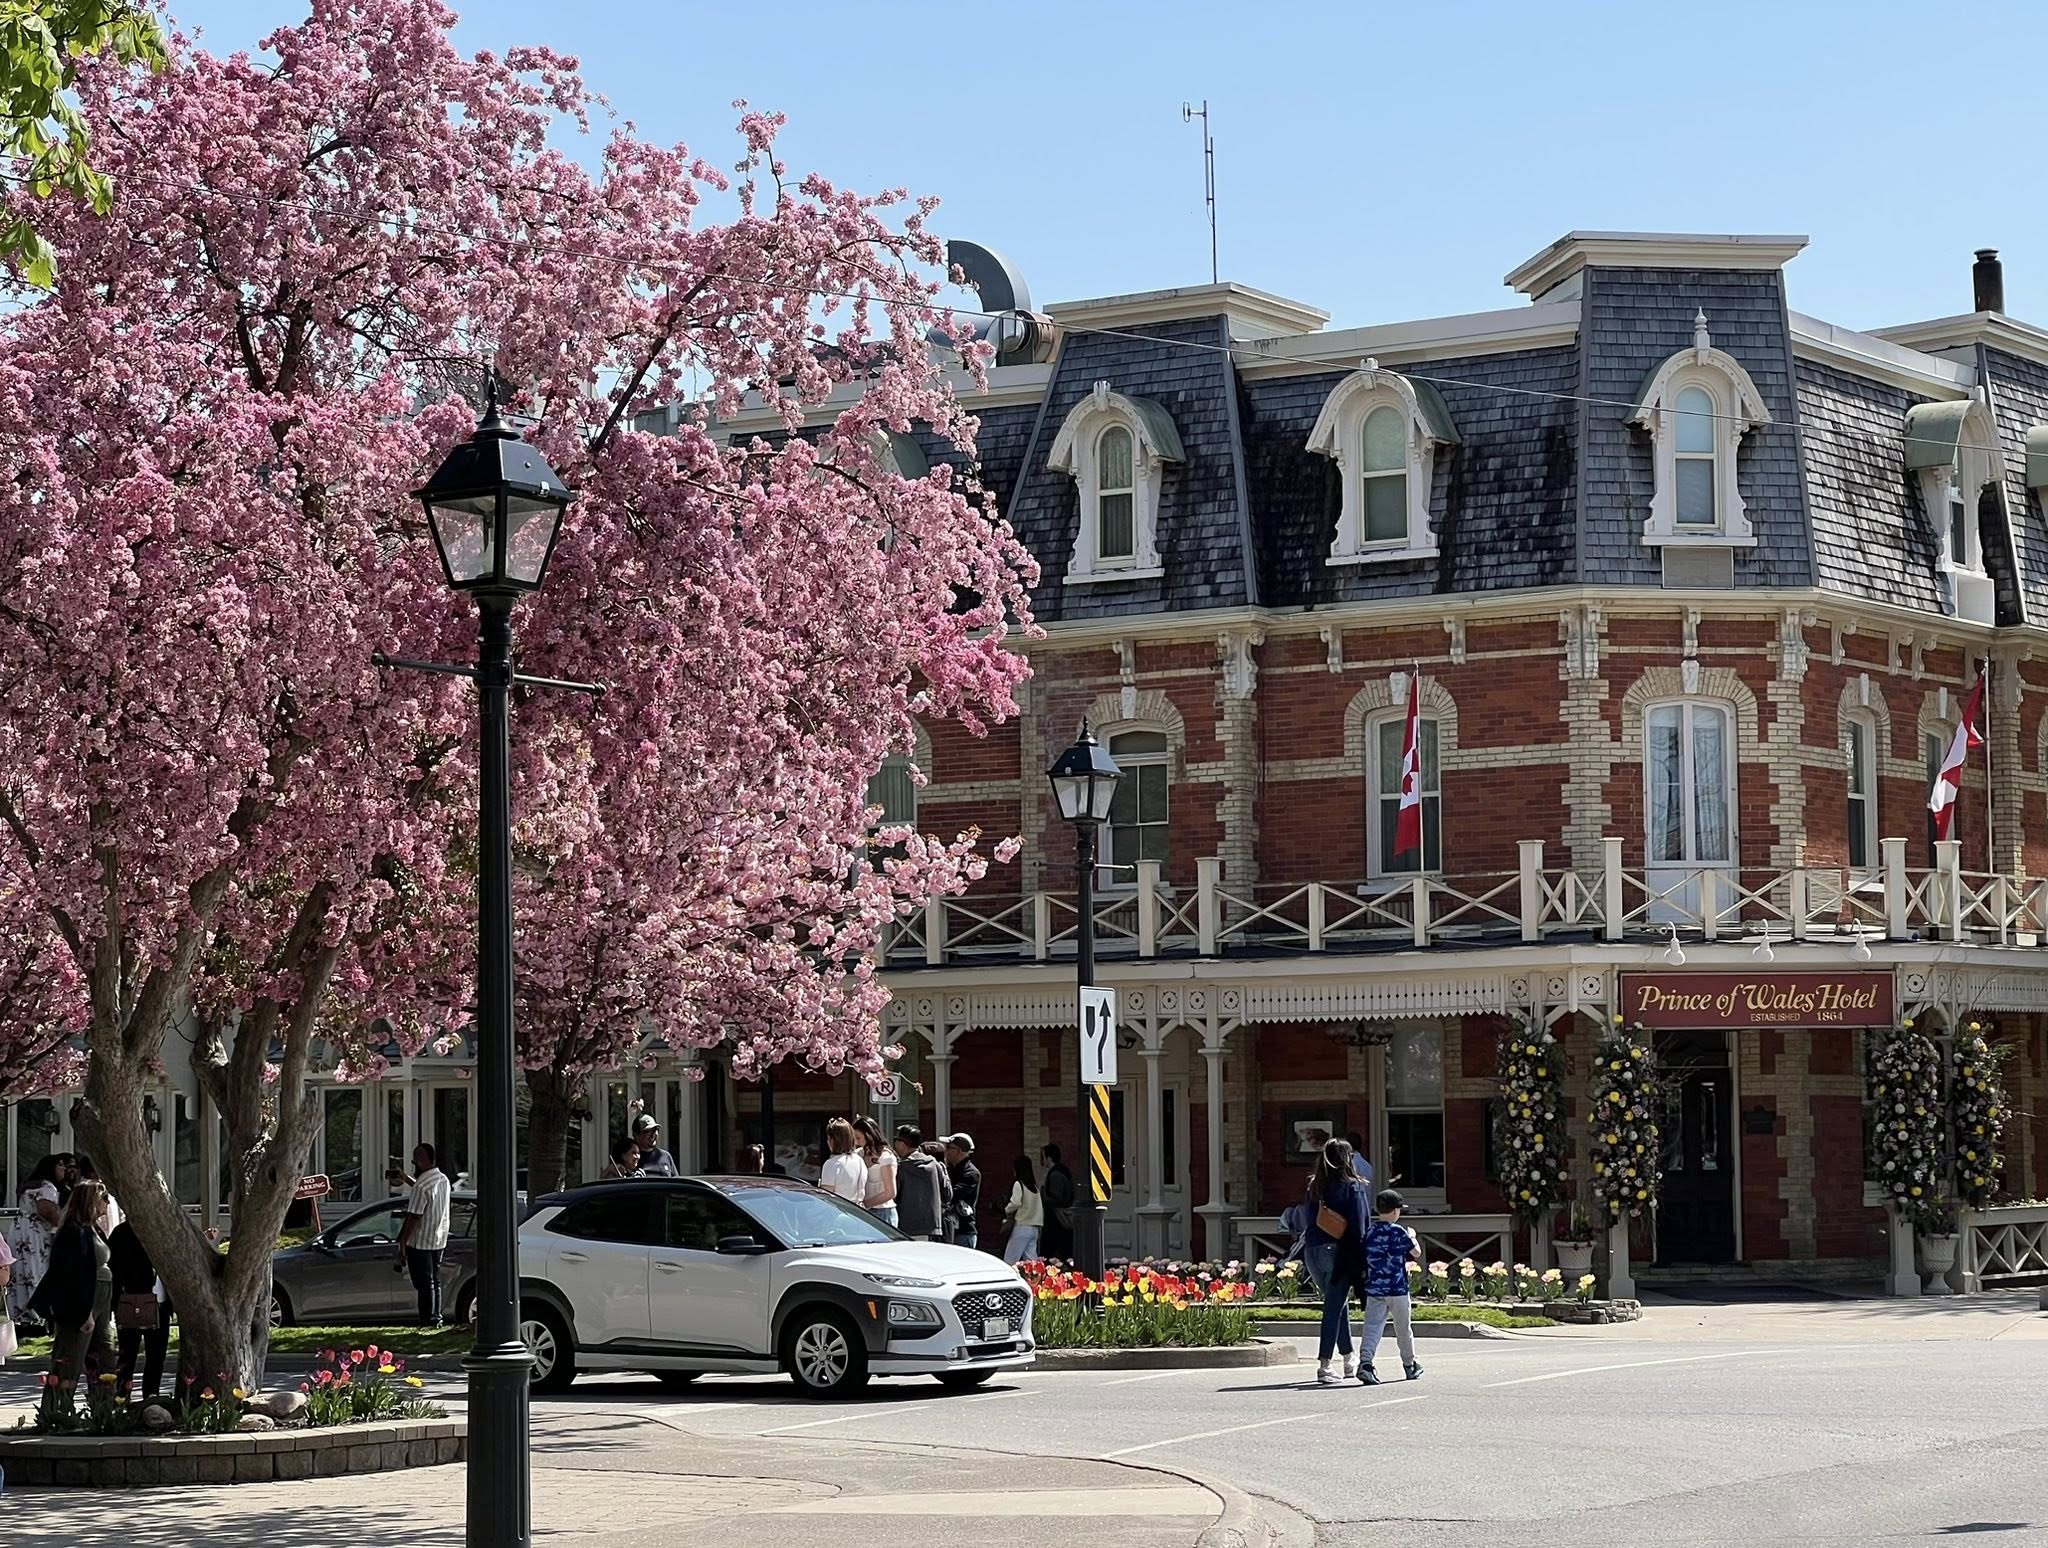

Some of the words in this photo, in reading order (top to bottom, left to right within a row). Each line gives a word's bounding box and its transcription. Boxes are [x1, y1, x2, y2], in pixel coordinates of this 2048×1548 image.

[1638, 985, 1711, 1011] Prince
[1716, 983, 1744, 1017] of
[1742, 984, 1815, 1012] Wales
[1815, 984, 1878, 1010] Hotel
[1750, 1013, 1801, 1022] ESTABLISHED
[1816, 1011, 1844, 1021] 1864
